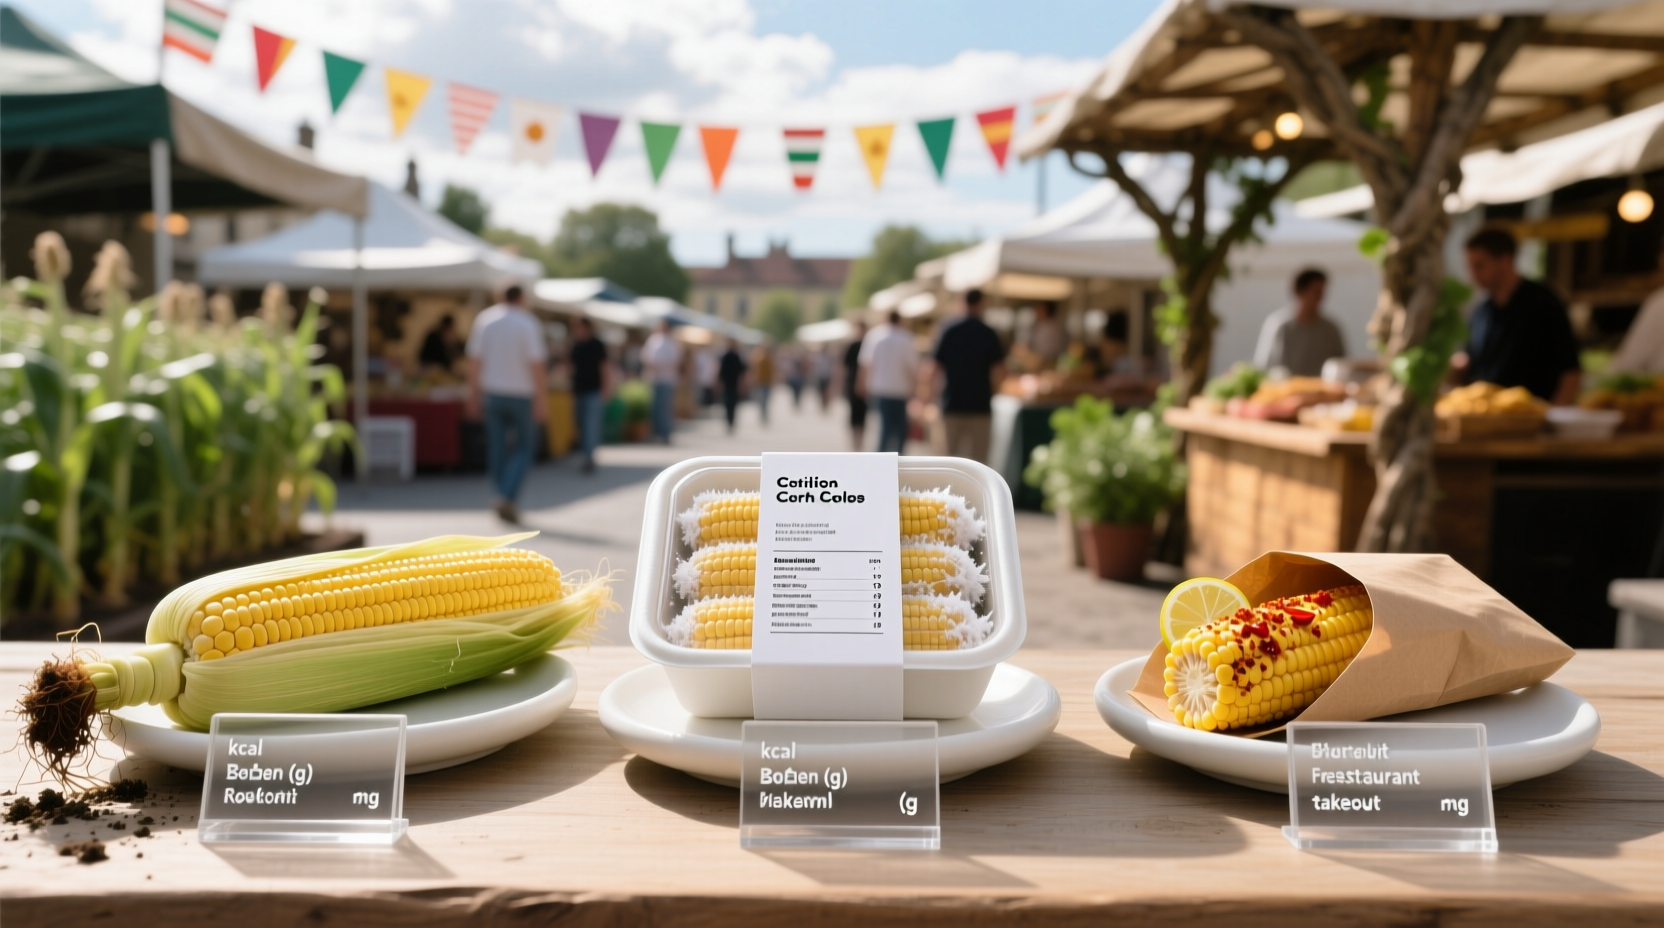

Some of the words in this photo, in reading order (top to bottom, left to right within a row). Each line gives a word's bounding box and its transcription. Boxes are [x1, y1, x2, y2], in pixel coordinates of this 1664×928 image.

[228, 738, 263, 756] kcal
[761, 741, 796, 759] kcal
[288, 763, 313, 786] (g)
[824, 767, 848, 790] (g)
[352, 791, 380, 810] mg
[899, 791, 918, 816] (g
[1311, 793, 1381, 811] takeout
[1440, 798, 1469, 817] mg
